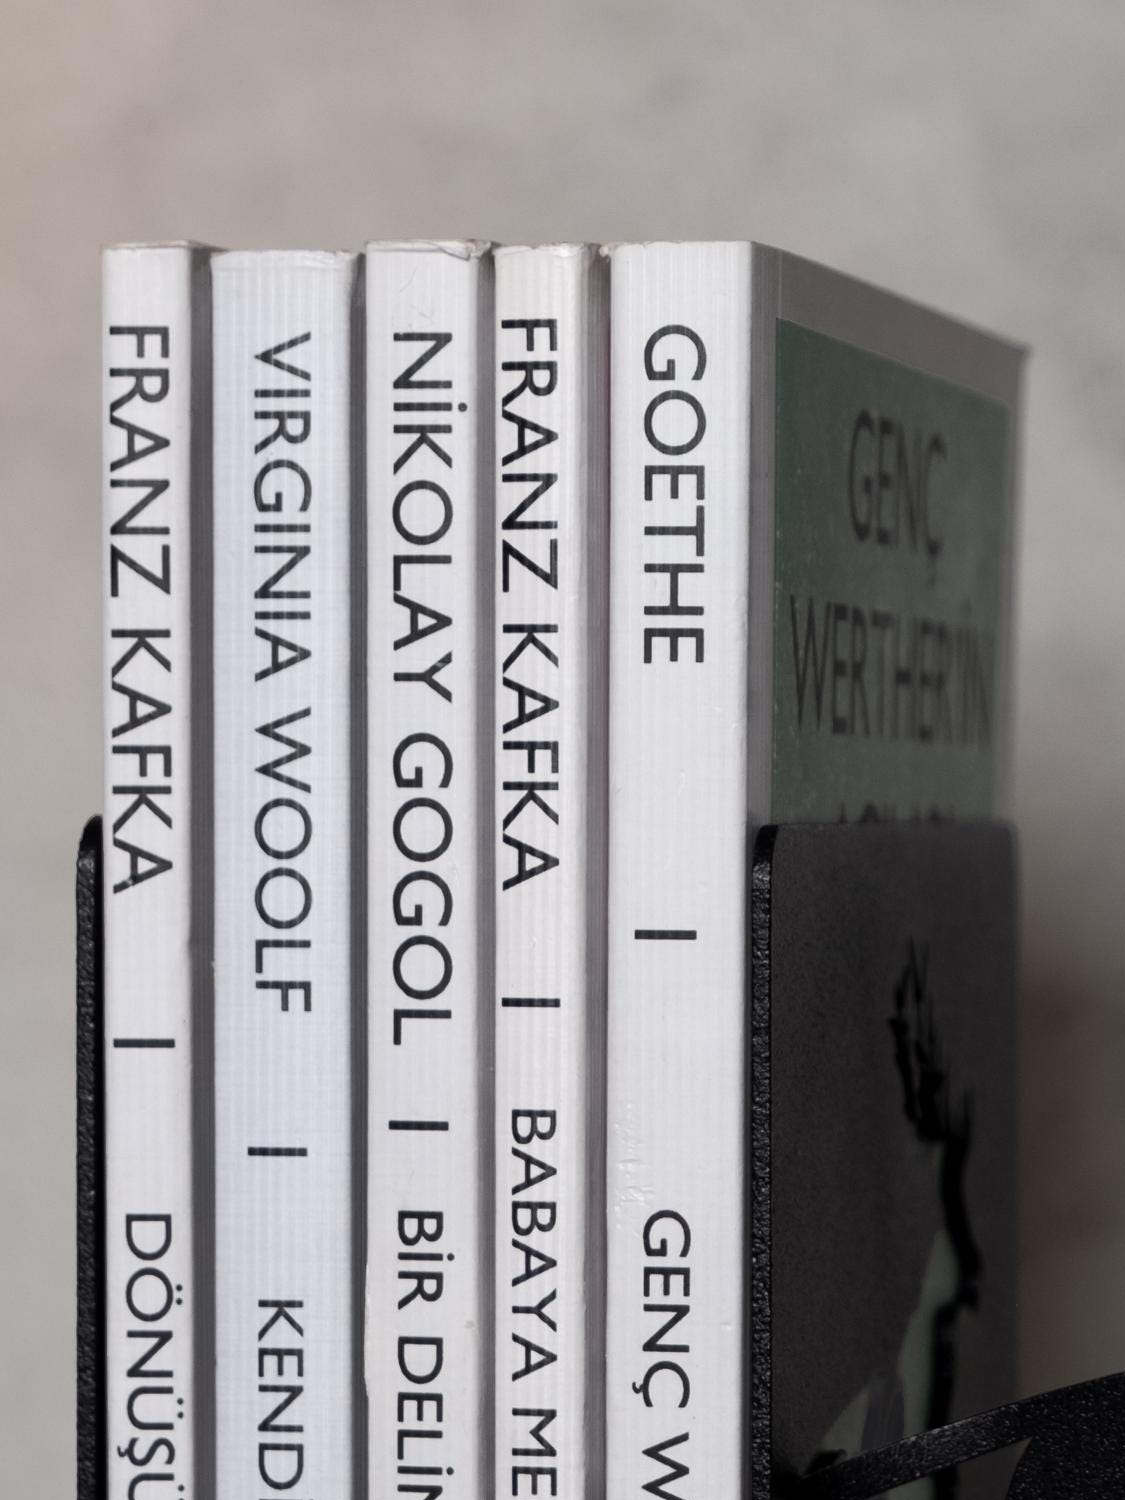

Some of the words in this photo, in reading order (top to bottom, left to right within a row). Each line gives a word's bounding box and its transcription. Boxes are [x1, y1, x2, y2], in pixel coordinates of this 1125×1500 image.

[109, 326, 172, 598] FRANZ
[254, 332, 311, 682] VIRGINIA
[392, 332, 468, 703] NİKOLAY
[501, 318, 558, 593] FRANZ
[643, 325, 707, 664] GOETHE
[848, 407, 946, 588] GENÇ
[111, 629, 174, 894] KAFKA
[255, 708, 312, 1012] WOOLF
[392, 732, 453, 1046] GOGOL
[501, 623, 560, 891] KAFKA
[397, 1210, 455, 1310] BİR
[511, 1109, 558, 1382] BABAYA
[631, 1209, 691, 1409] GENÇ
